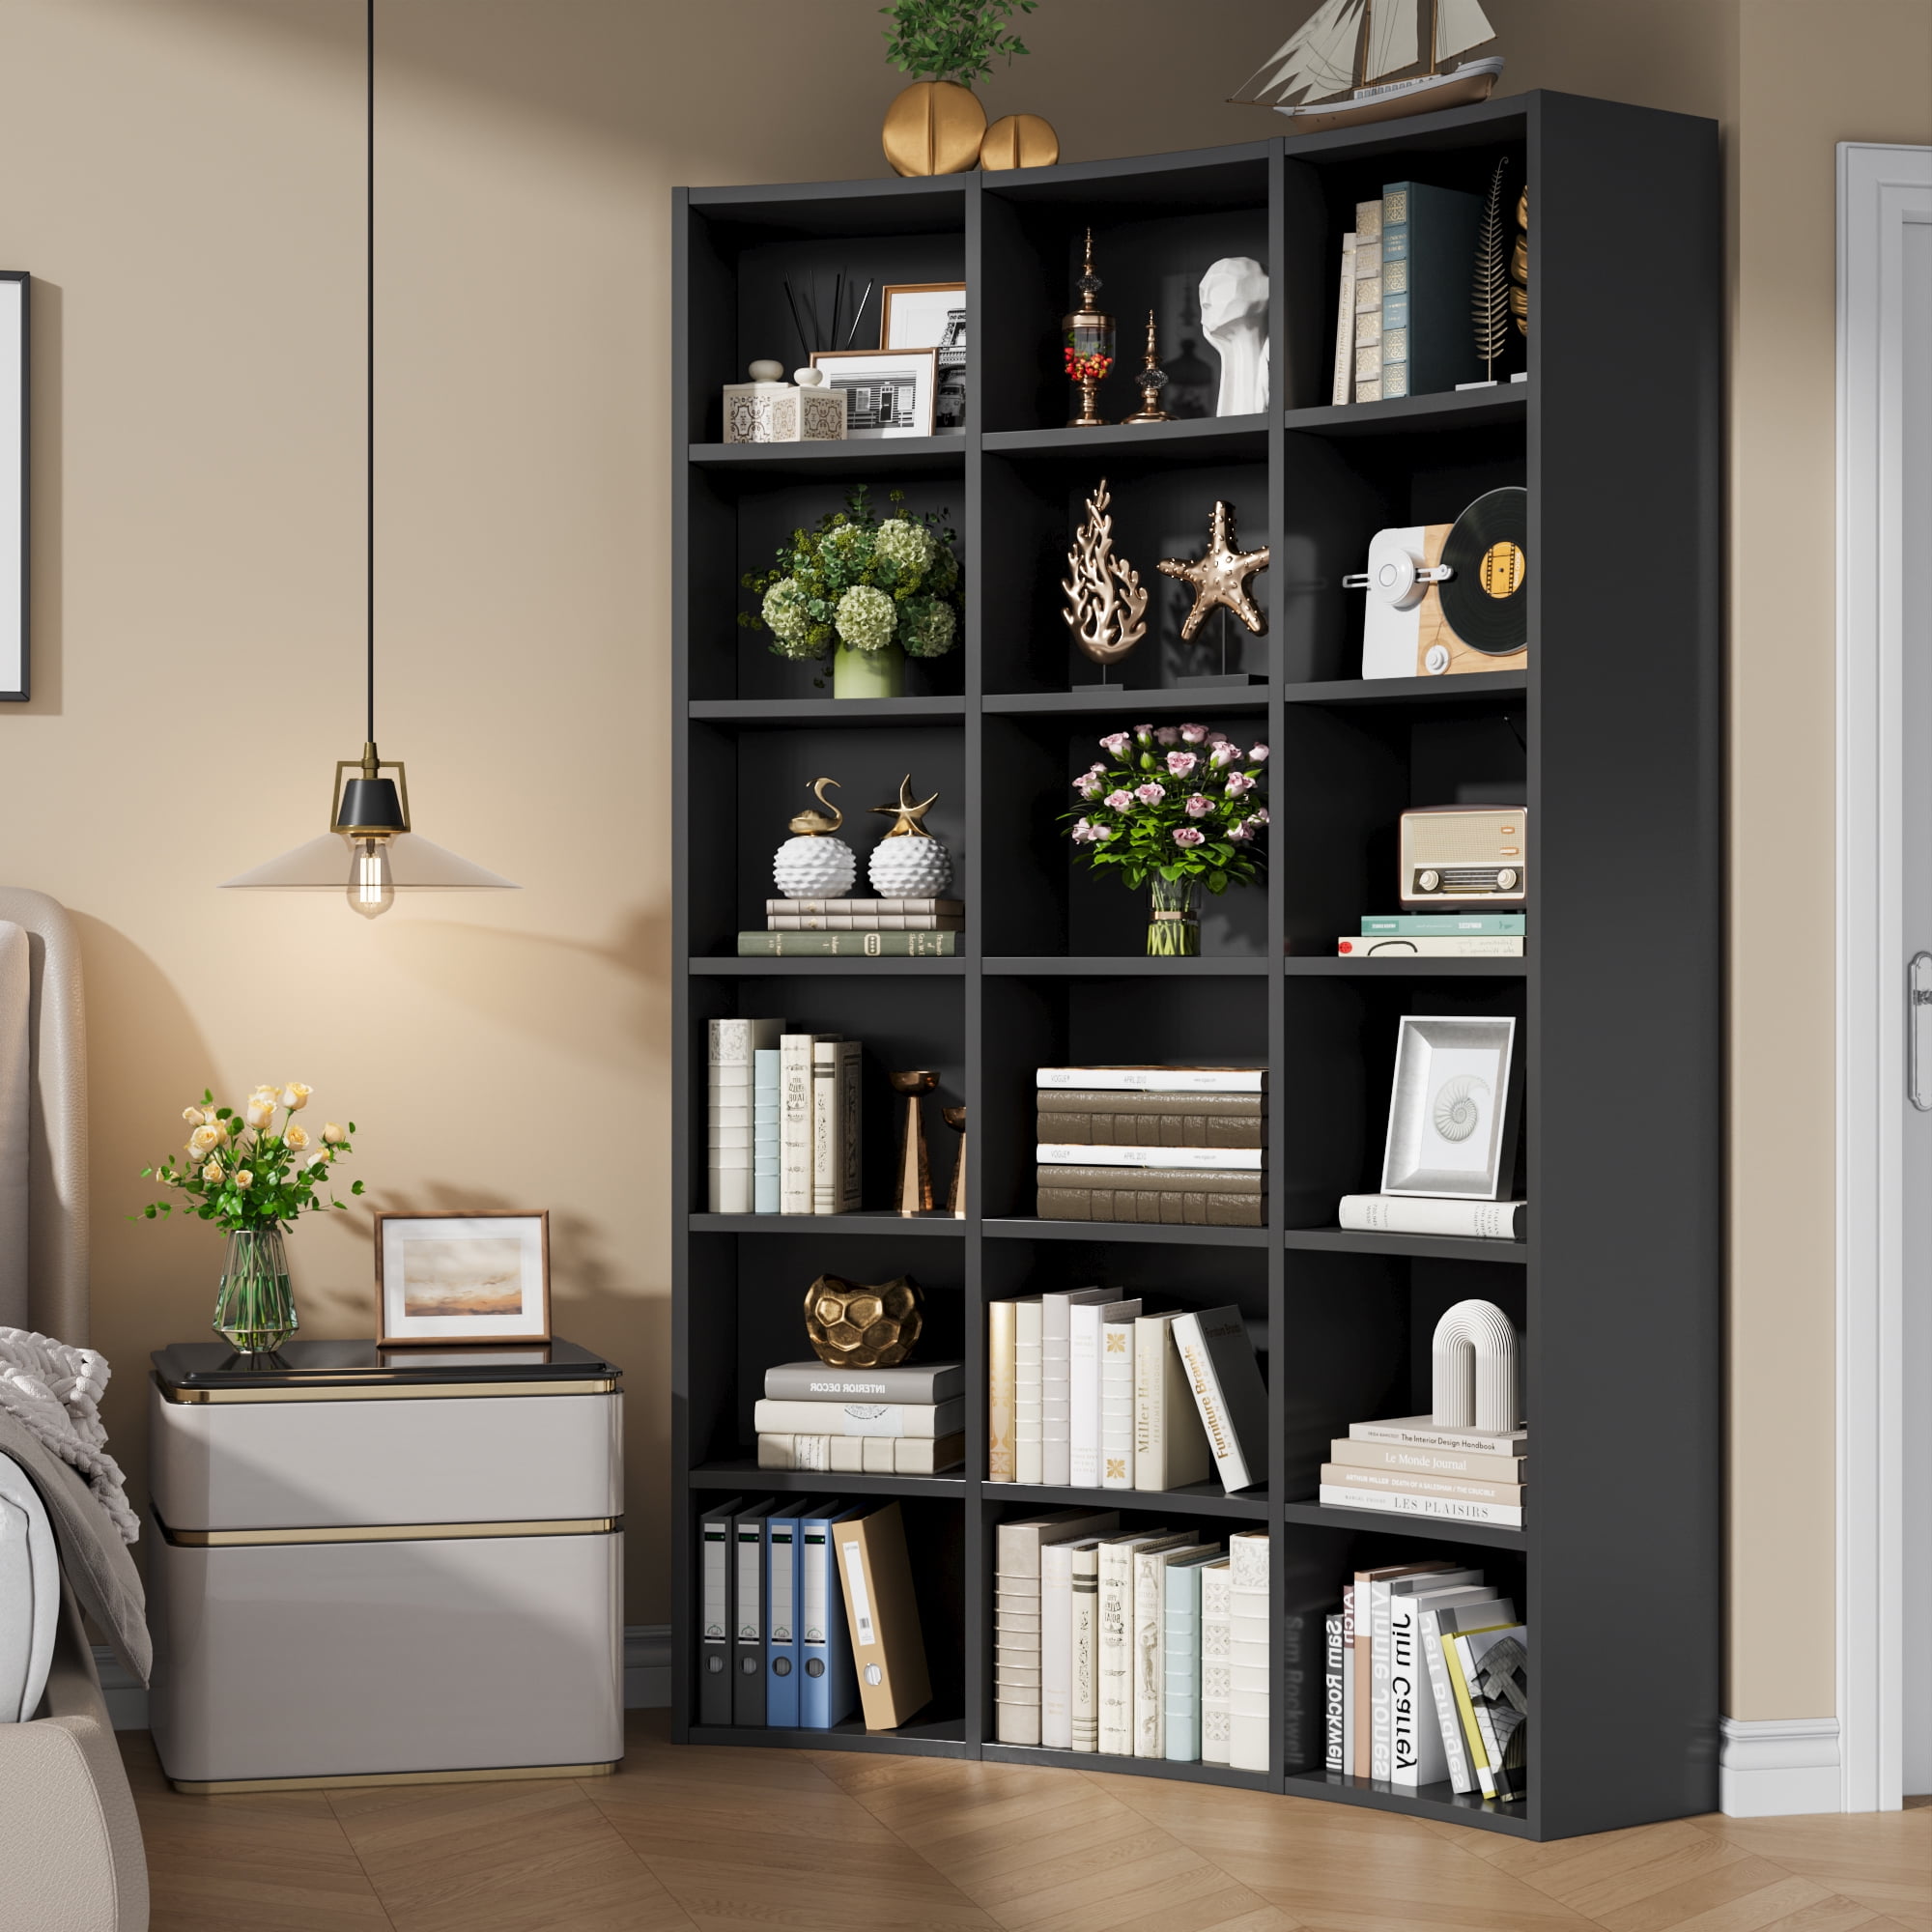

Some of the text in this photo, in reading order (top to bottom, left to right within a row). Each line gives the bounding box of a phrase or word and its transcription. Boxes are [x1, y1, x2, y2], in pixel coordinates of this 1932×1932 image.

[1184, 1344, 1228, 1460] Furniture Brands
[1138, 1404, 1150, 1454] Miller
[1402, 1434, 1413, 1442] The
[1413, 1435, 1436, 1444] Interior
[1437, 1437, 1460, 1447] Design
[1462, 1439, 1495, 1450] Handbook
[1385, 1452, 1467, 1470] Le Monde Journal
[1394, 1496, 1418, 1510] LES
[1425, 1499, 1490, 1518] PLAISIRS
